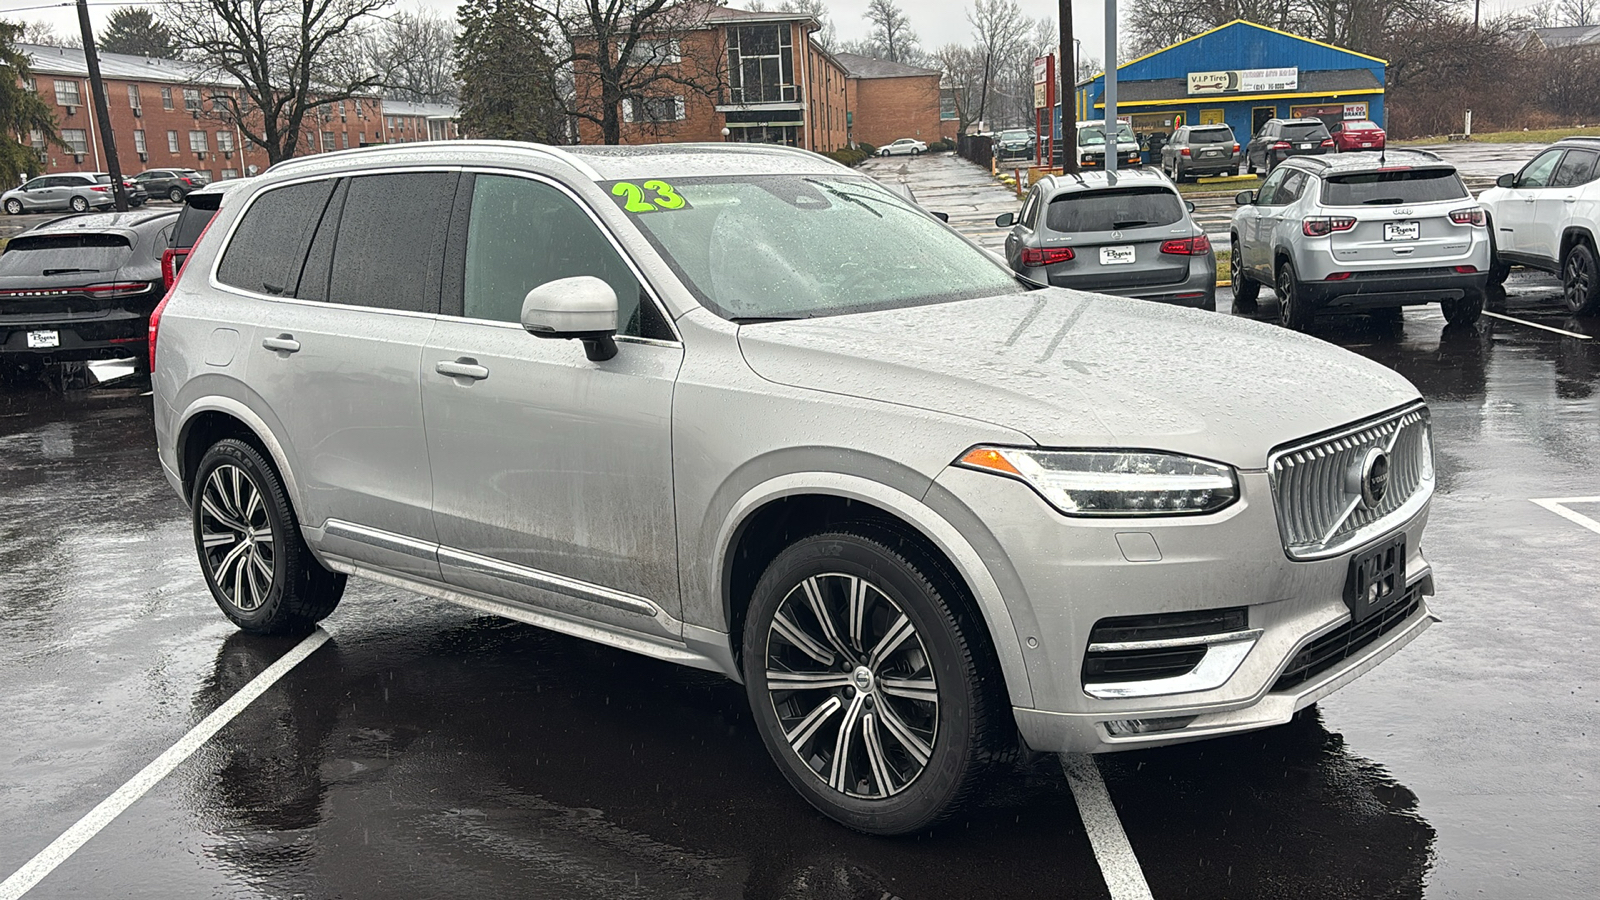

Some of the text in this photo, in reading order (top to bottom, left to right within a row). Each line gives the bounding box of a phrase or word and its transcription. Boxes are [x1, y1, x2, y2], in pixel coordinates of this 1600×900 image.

[612, 180, 685, 213] 23
[1388, 225, 1416, 236] Byers
[1103, 249, 1132, 259] Byers
